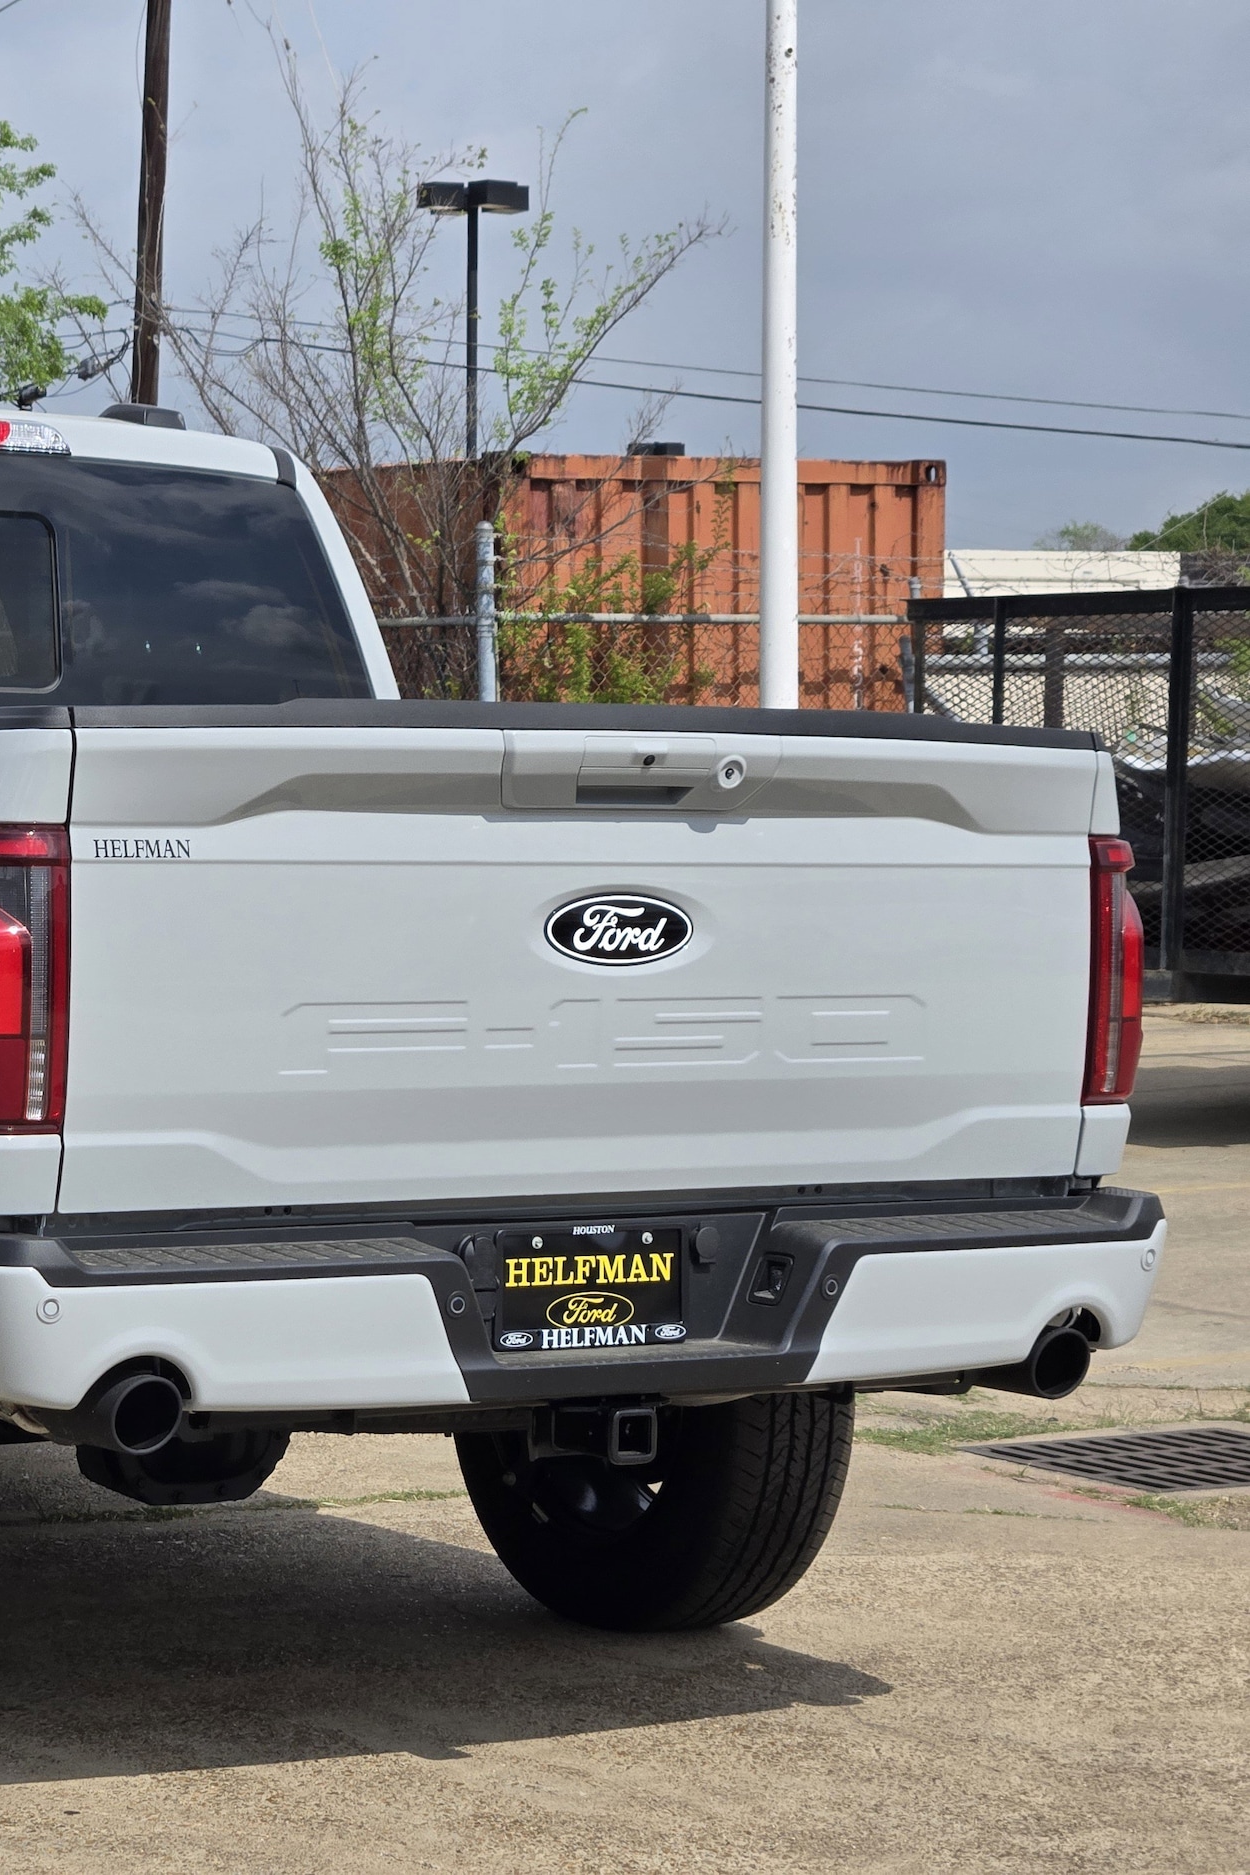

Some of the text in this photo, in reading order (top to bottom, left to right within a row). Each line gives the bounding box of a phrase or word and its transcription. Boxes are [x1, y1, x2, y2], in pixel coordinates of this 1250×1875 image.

[93, 839, 191, 859] HELFMAN
[572, 904, 668, 951] Ford
[572, 1224, 615, 1236] HOUSTON
[505, 1252, 675, 1288] HELFMAN
[562, 1296, 619, 1325] Ford
[541, 1324, 647, 1349] HELFMAN
